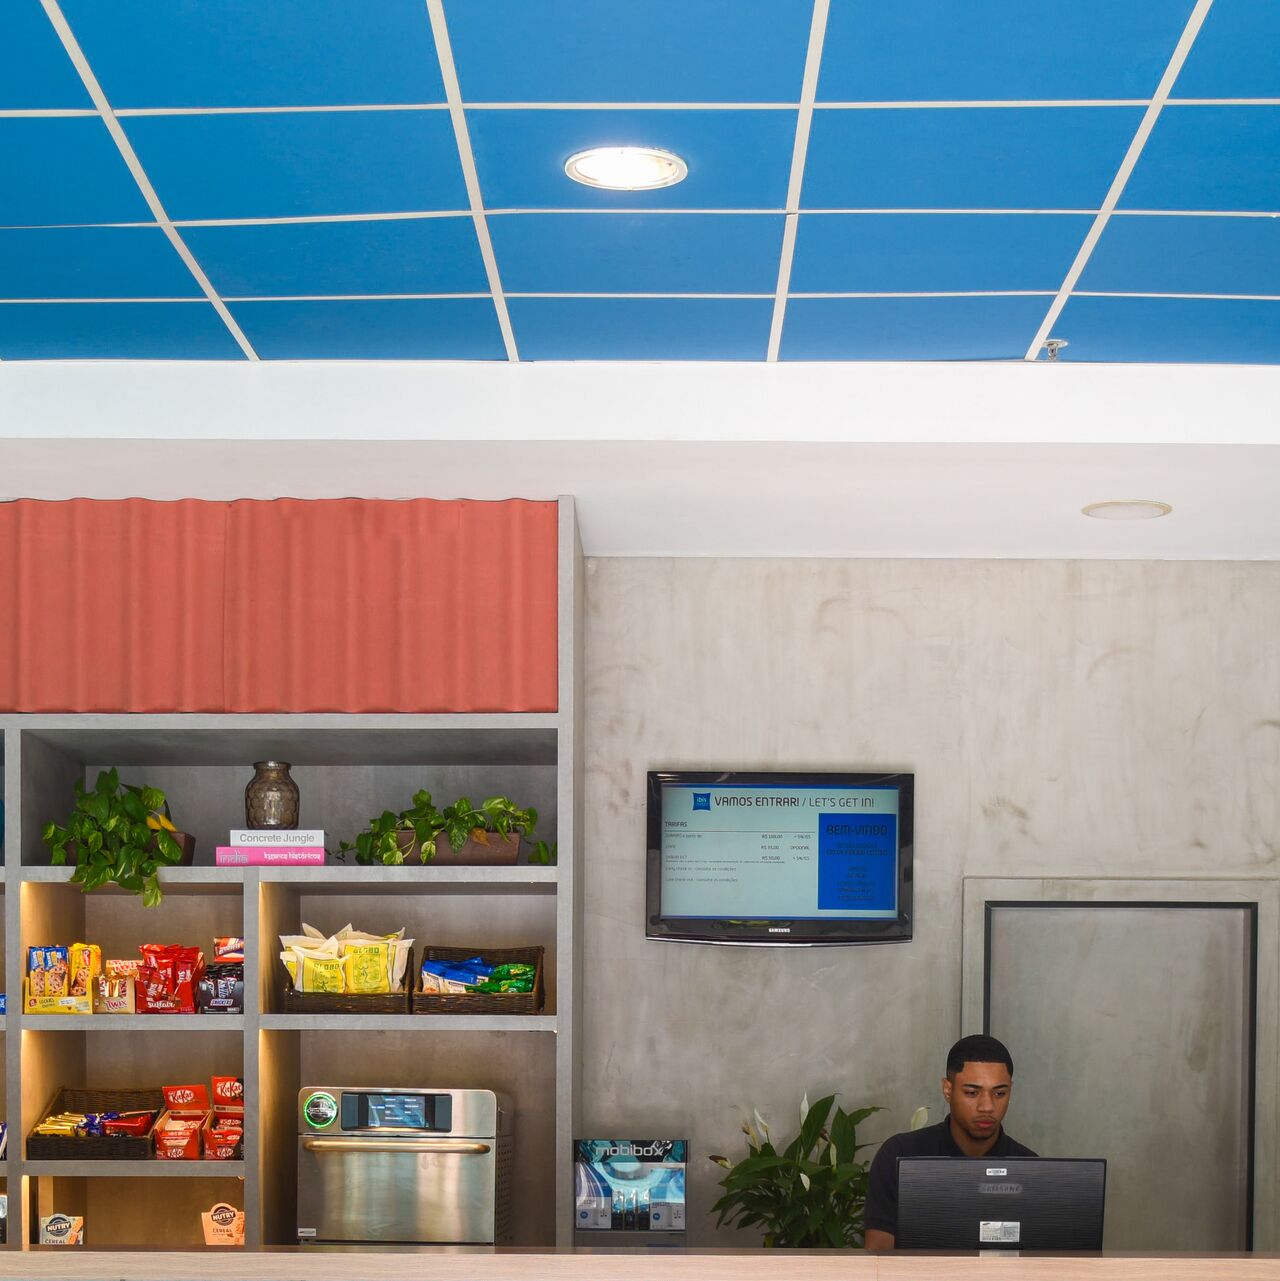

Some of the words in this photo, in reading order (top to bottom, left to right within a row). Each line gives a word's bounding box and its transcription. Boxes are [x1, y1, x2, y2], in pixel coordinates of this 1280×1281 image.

[714, 796, 753, 807] VAMOS
[755, 796, 800, 807] ENTRAR!
[808, 797, 836, 808] LET'S
[838, 797, 858, 808] GET
[239, 833, 282, 843] Concrete
[283, 833, 315, 844] Jungle
[595, 1144, 664, 1157] mobibox
[211, 1212, 235, 1222] NUTRY
[46, 1222, 71, 1232] NUTRY
